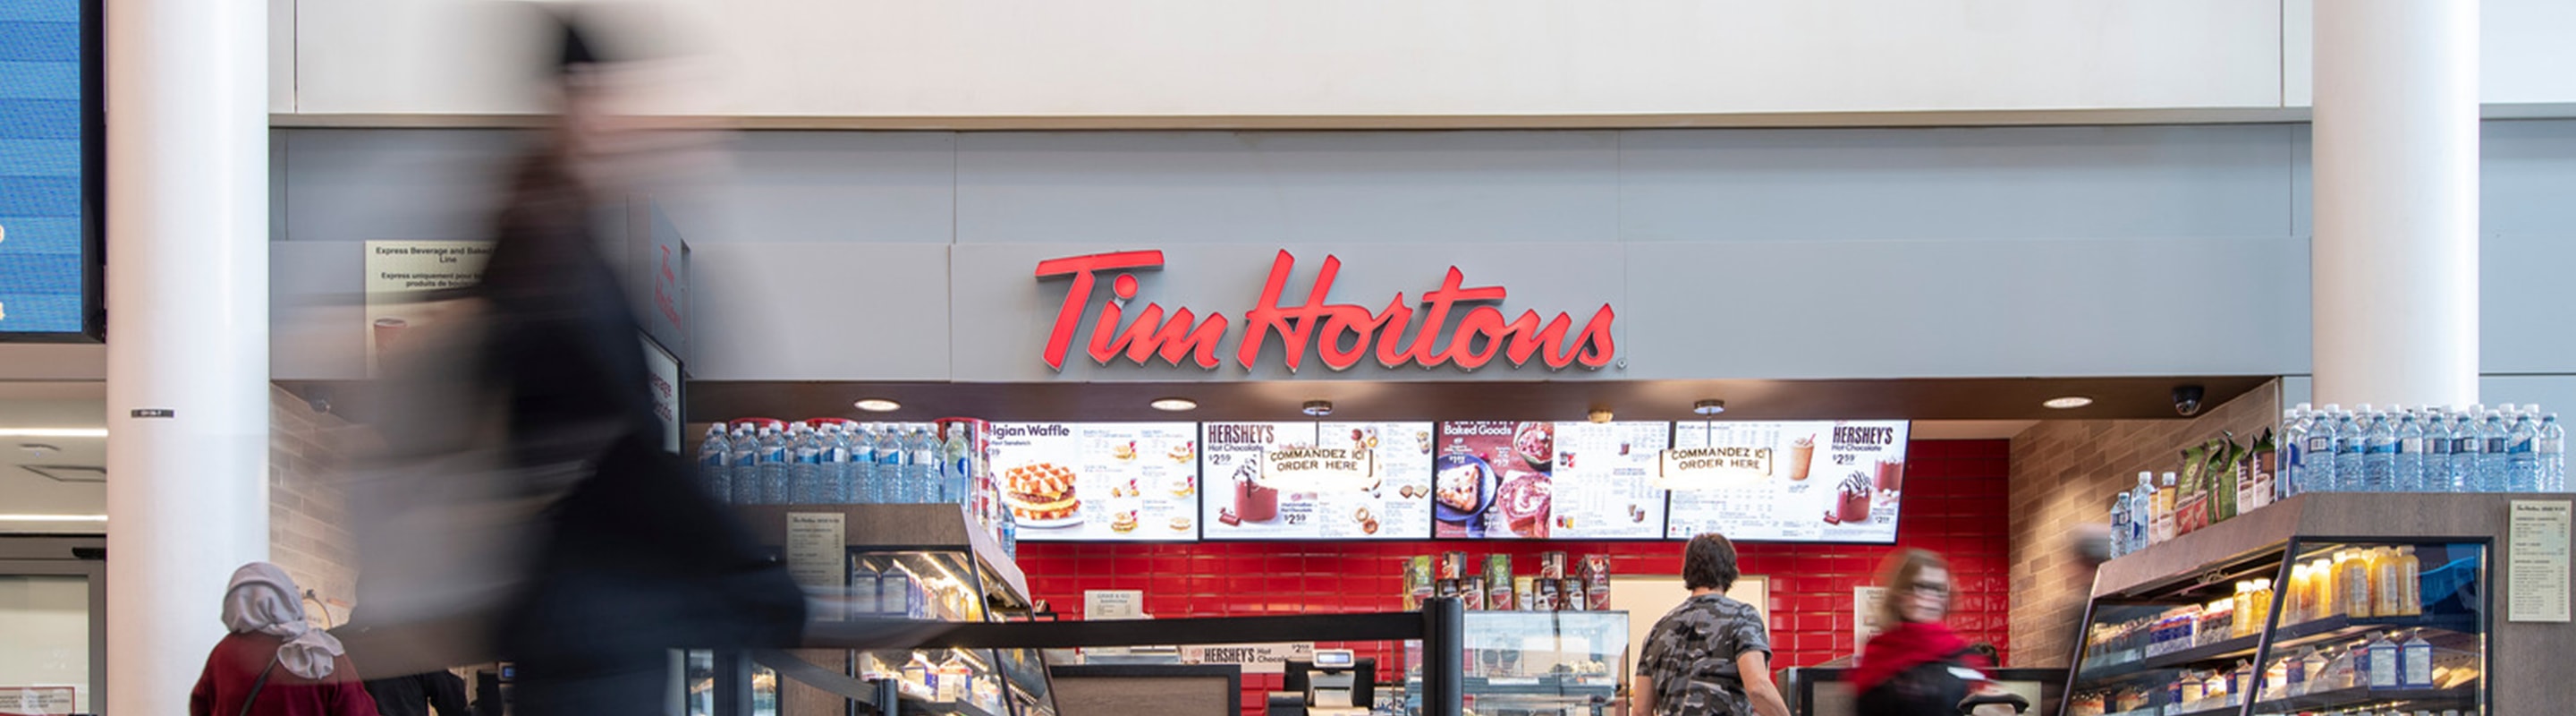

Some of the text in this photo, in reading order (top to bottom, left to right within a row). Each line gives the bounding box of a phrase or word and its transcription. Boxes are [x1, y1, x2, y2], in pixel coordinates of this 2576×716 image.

[376, 247, 408, 256] Express
[411, 247, 448, 256] Beverage
[451, 247, 465, 255] and
[439, 255, 457, 264] Line
[381, 272, 410, 280] Express
[1036, 249, 1615, 373] Tim Hortons
[989, 424, 1071, 439] lgian Waffle
[1208, 424, 1275, 444] HERSHEY'S
[1444, 424, 1513, 436] Baked Goods
[1833, 425, 1894, 445] HERSHEY'S
[1270, 448, 1347, 462] COMMANDEZ
[1671, 448, 1750, 460] COMMANDEZ
[1276, 461, 1359, 472] ORDER HERE
[1678, 459, 1760, 471] ORDER HERE
[1204, 647, 1254, 663] HERSHEY'S
[1257, 654, 1289, 663] Chocola
